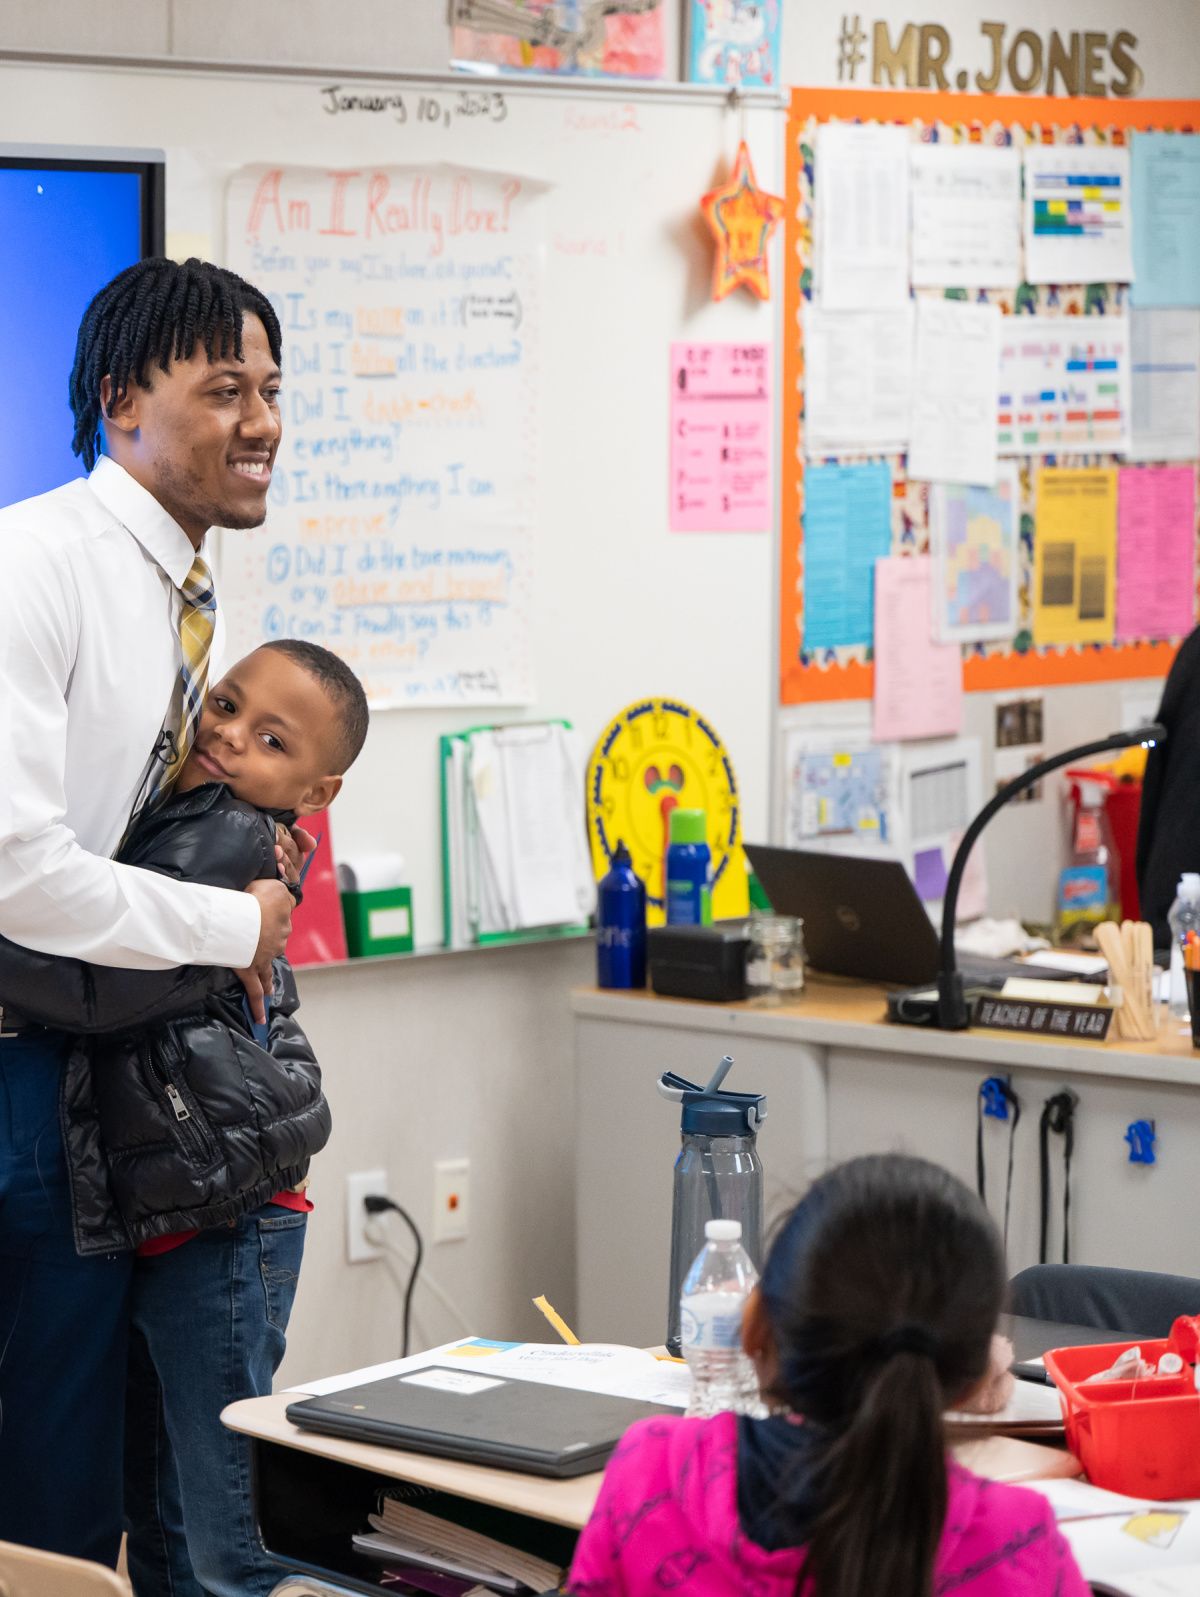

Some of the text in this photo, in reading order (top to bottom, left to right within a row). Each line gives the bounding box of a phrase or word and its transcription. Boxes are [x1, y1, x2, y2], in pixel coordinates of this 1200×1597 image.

[321, 85, 408, 125] January
[455, 90, 508, 123] 2023
[620, 104, 643, 133] 2
[246, 169, 522, 257] Am I Really Done?
[325, 309, 354, 340] my
[290, 342, 321, 377] Did
[329, 342, 348, 376] I
[423, 342, 449, 374] the
[291, 388, 324, 427] Did
[332, 386, 351, 422] I
[293, 470, 320, 503] Is
[446, 462, 465, 496] I
[295, 544, 326, 577] Did
[331, 544, 348, 576] I
[329, 612, 345, 636] I
[980, 1001, 1107, 1035] TEACHER OF THE YEAR
